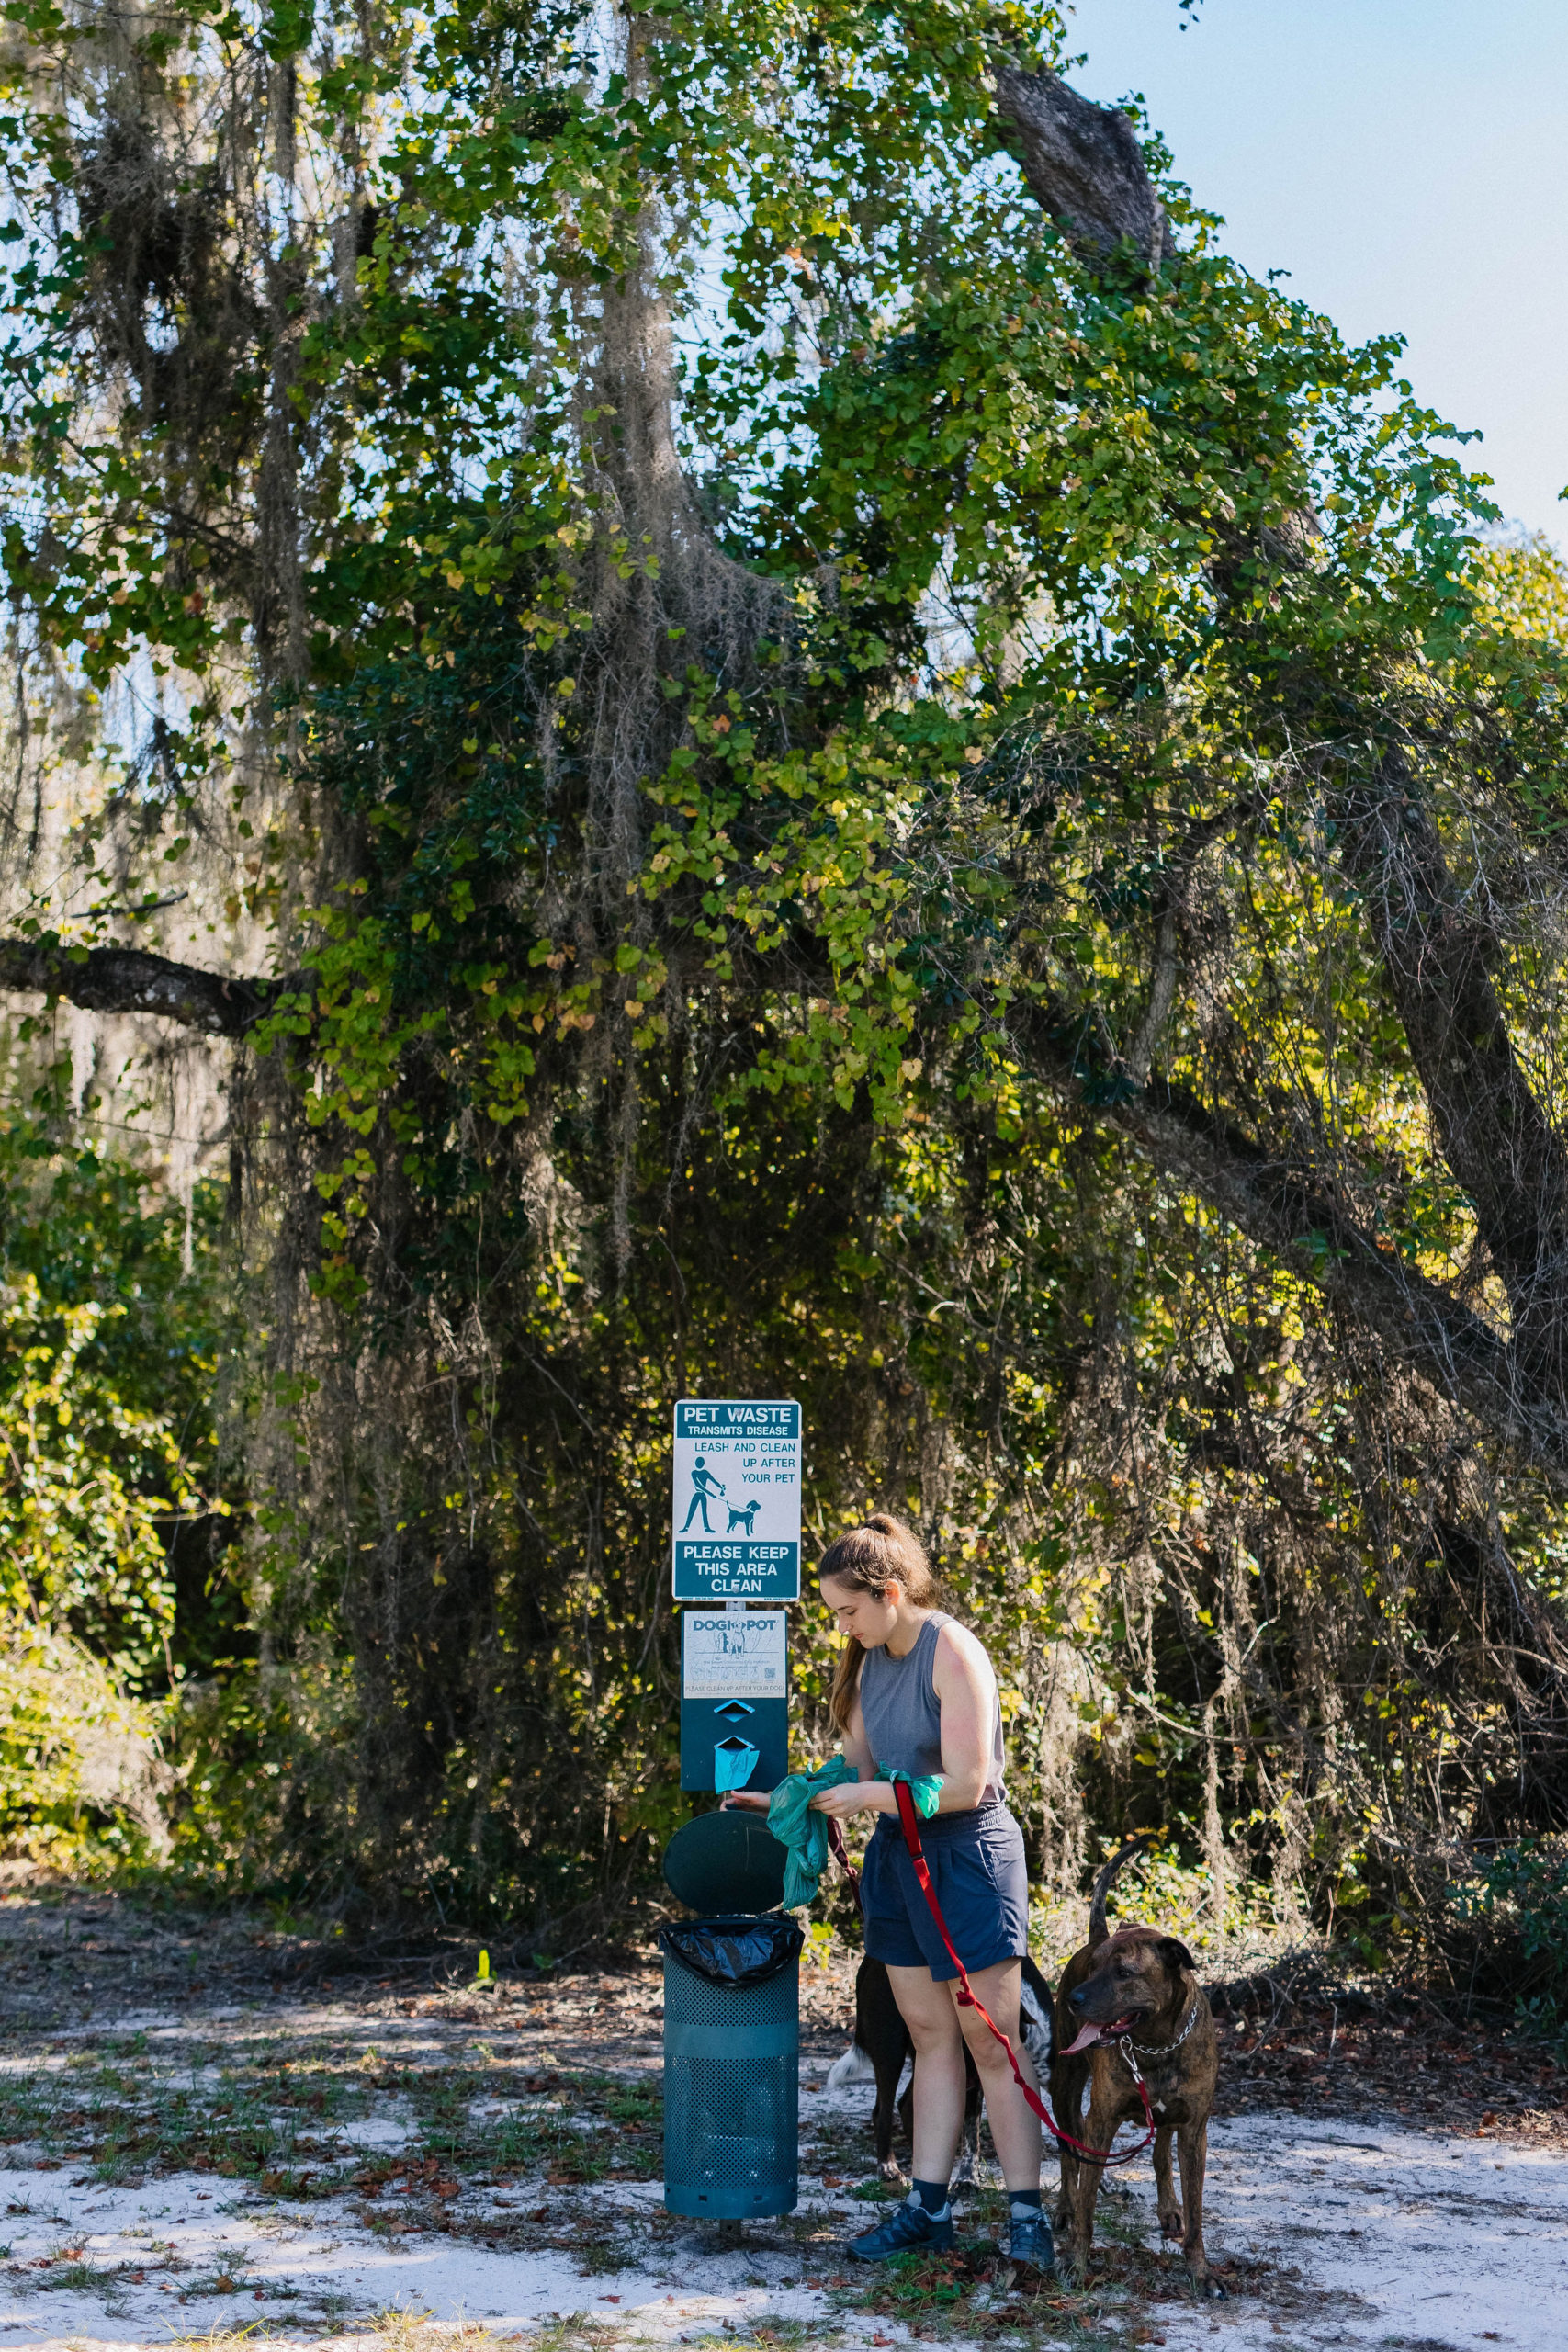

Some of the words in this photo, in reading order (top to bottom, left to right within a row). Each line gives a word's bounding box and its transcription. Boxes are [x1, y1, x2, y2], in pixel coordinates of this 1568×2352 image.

[683, 1407, 719, 1423] PET
[727, 1407, 792, 1423] WASTE
[687, 1425, 743, 1436] TRANSMITS
[746, 1426, 788, 1436] DISEASE
[694, 1442, 729, 1452] LEASH
[733, 1442, 756, 1453] AND
[760, 1442, 795, 1453] CLEAN
[742, 1458, 757, 1468] UP
[761, 1458, 795, 1468] AFTER
[741, 1473, 771, 1483] YOUR
[774, 1473, 795, 1483] PET
[683, 1545, 742, 1559] PLEASE
[749, 1546, 789, 1559] KEEP
[694, 1562, 730, 1576] THIS
[736, 1563, 778, 1576] AREA
[710, 1578, 762, 1592] CLEAN
